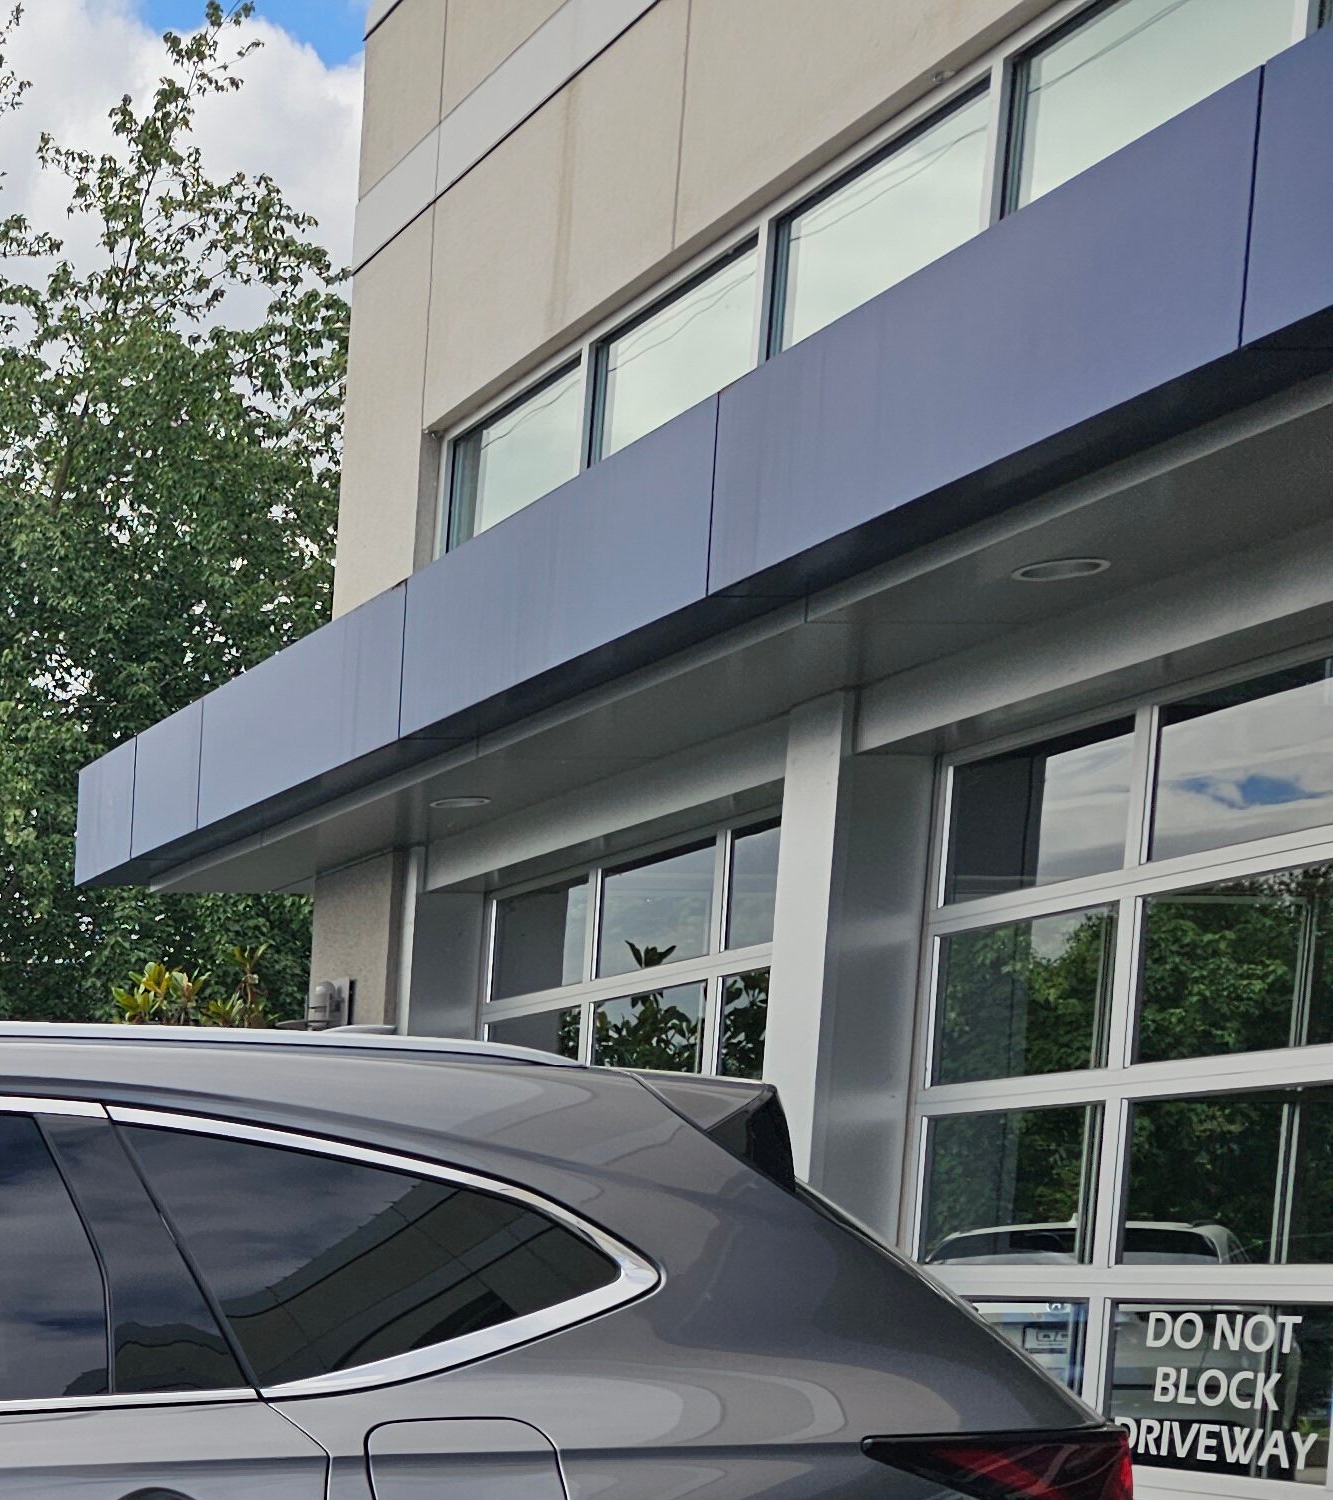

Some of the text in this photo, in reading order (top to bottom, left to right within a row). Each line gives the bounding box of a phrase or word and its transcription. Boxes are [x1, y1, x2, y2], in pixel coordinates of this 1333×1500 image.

[1146, 1312, 1303, 1354] DO NOT
[1153, 1366, 1282, 1411] BLOCK
[1114, 1416, 1319, 1470] DRIVEWAY
